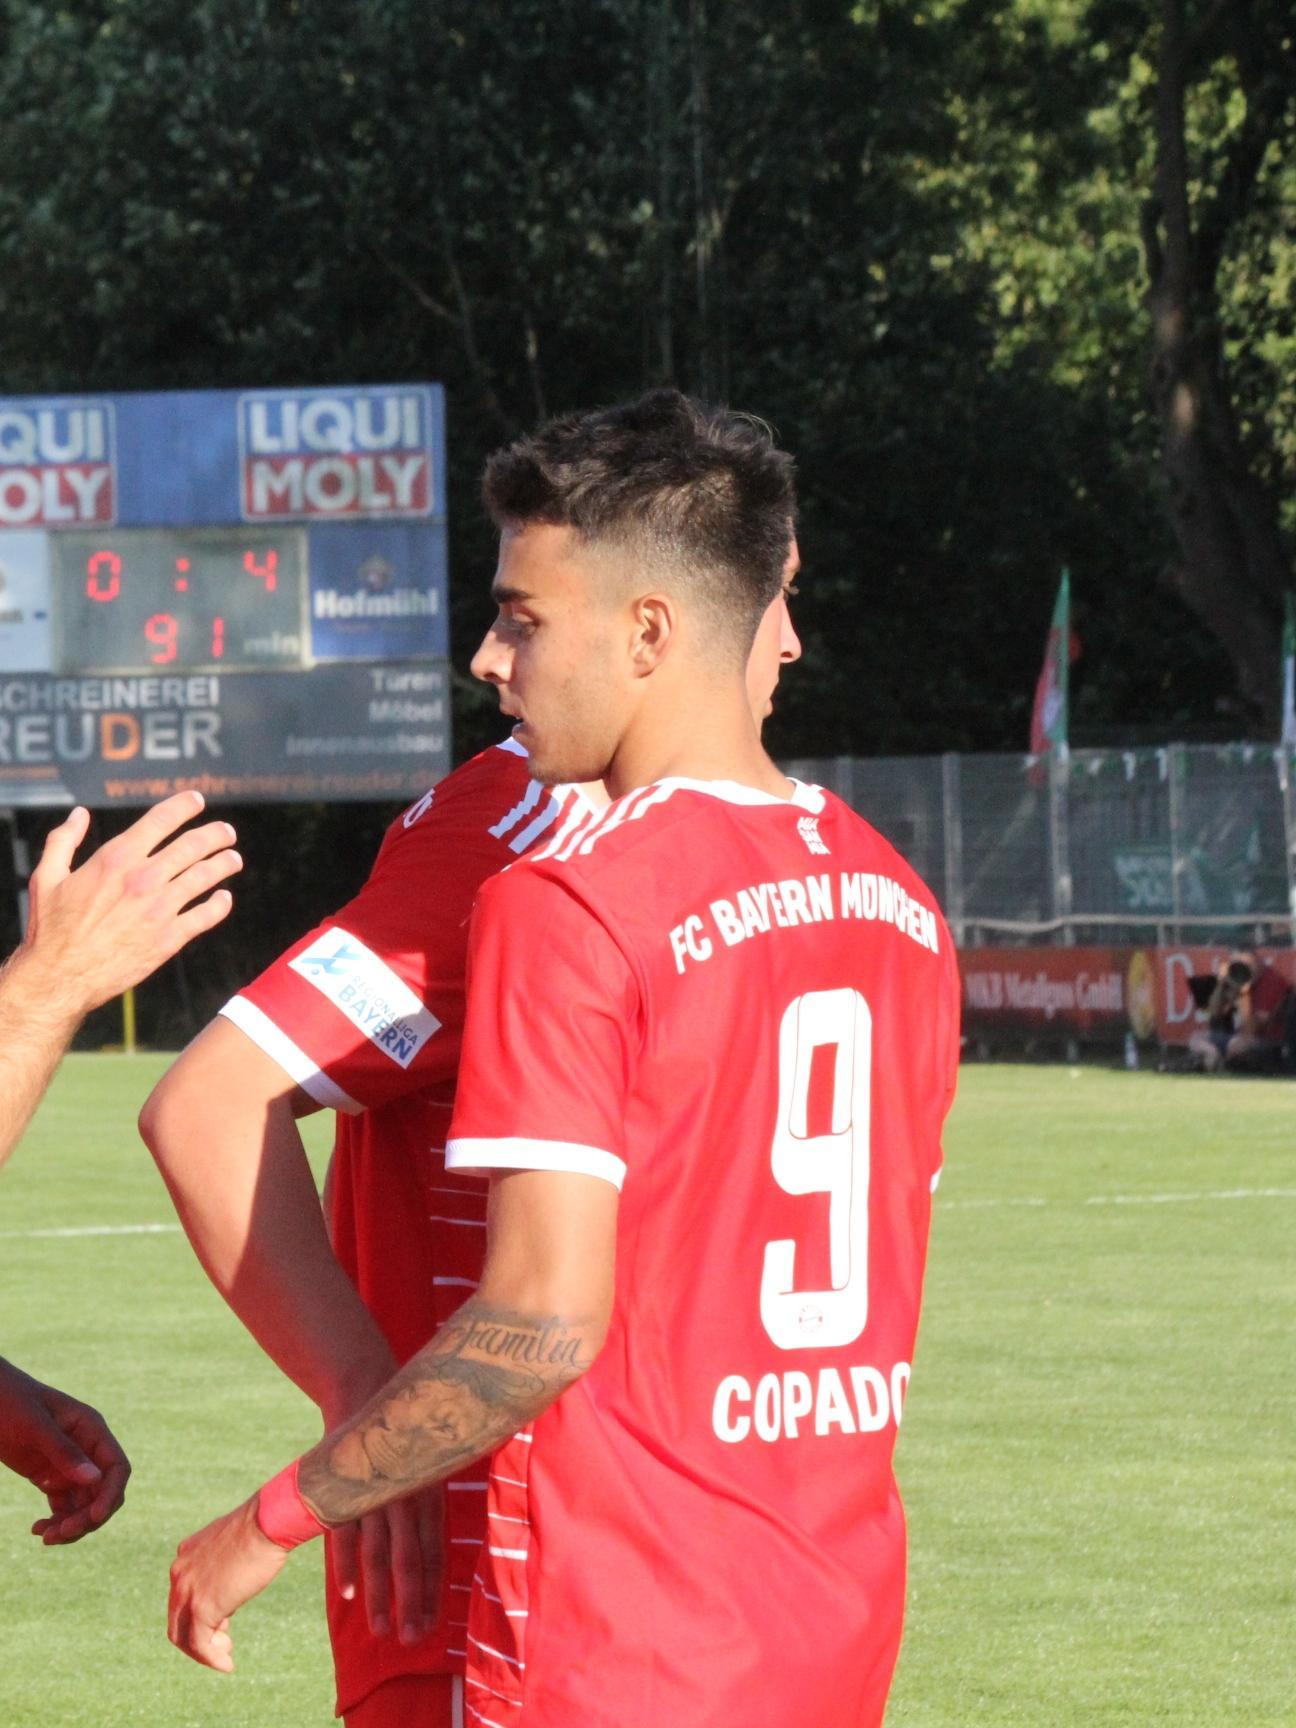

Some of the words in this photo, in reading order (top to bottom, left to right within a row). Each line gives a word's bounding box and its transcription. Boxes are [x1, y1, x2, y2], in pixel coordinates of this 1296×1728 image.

[251, 397, 420, 453] LIQUI
[254, 455, 425, 513] MOLY
[86, 551, 122, 602] 0
[243, 549, 278, 592] 4
[668, 914, 713, 976] FC
[709, 873, 834, 948] BAYERN
[338, 983, 414, 1060] BAYERN
[759, 986, 873, 1351] 9
[712, 1361, 912, 1443] COPADO
